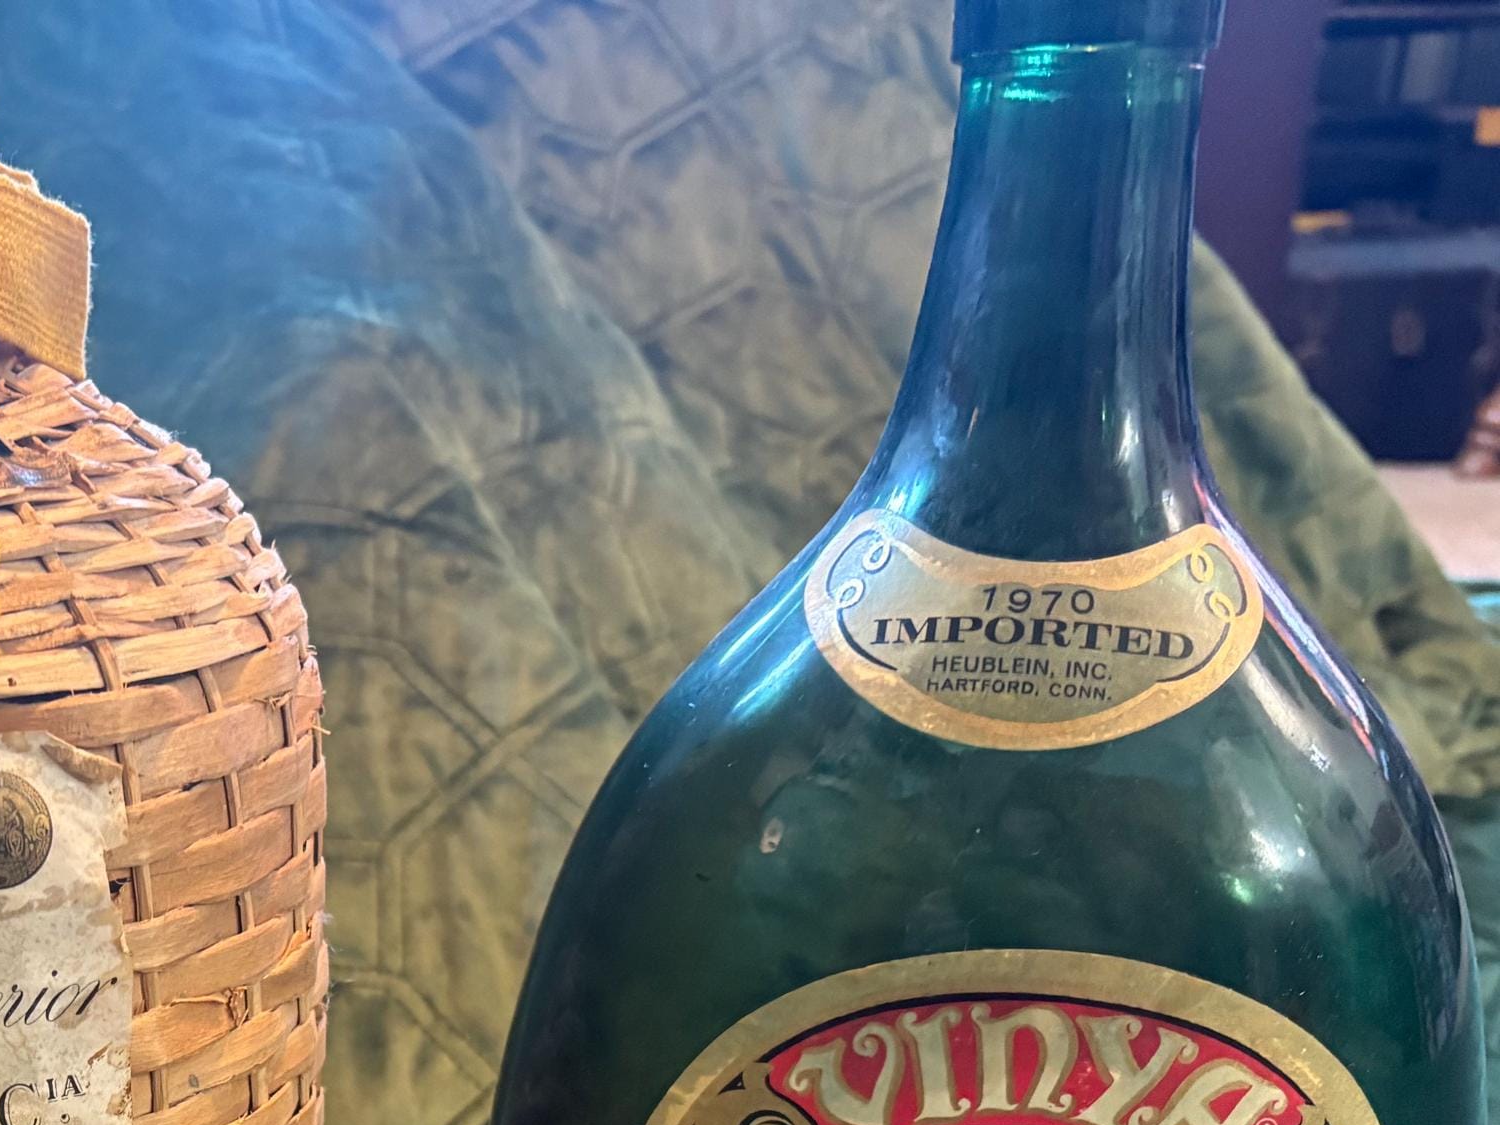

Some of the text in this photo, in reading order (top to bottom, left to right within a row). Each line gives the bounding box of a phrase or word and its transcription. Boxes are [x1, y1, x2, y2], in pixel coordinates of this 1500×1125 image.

[982, 586, 1095, 616] 1970
[870, 616, 1195, 661] IMPORTED
[932, 655, 1113, 681] HEUBLEIN, INC.
[927, 677, 1113, 702] HARTFORD, CONN.
